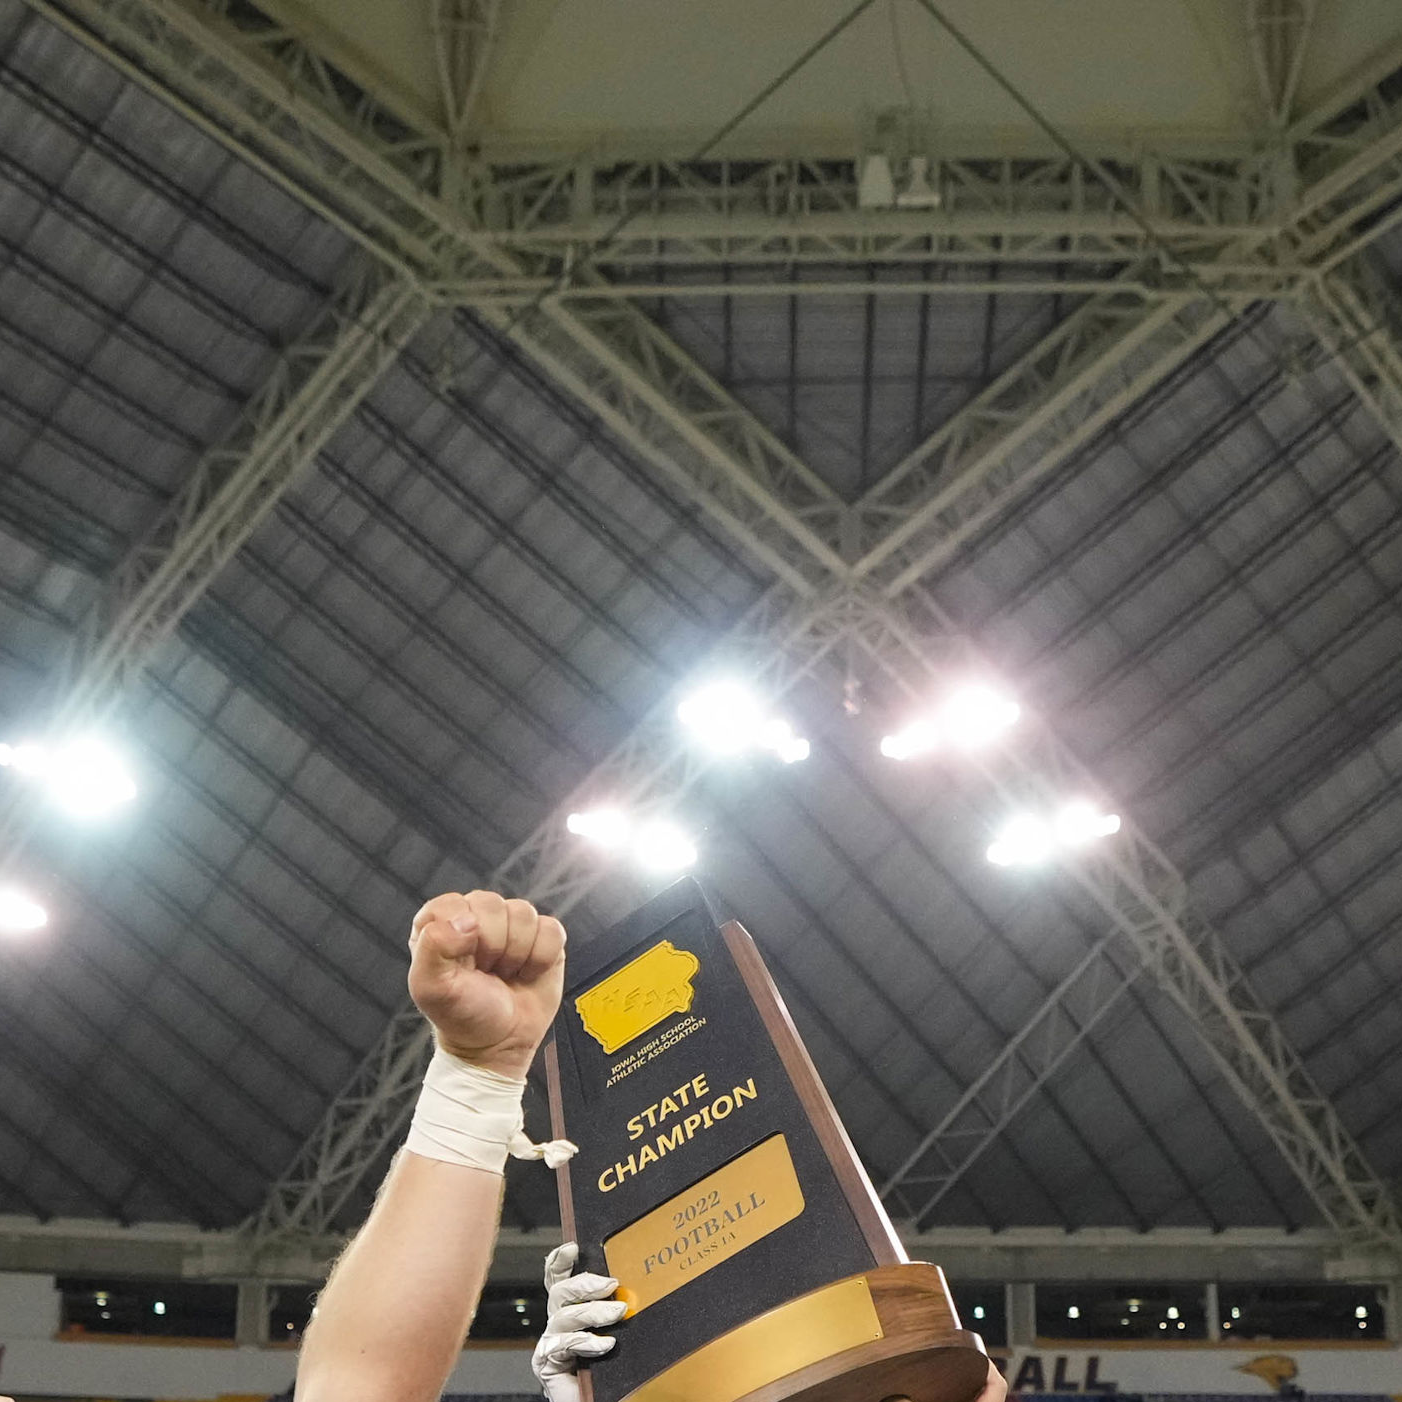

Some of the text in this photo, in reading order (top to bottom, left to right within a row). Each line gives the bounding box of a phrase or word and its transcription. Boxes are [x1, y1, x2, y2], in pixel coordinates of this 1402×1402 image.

[606, 1017, 707, 1088] ATHLETIC ASSOCIATION
[611, 1015, 697, 1075] IOWA HIGH SCHOOL
[597, 1078, 759, 1194] CHAMPION
[626, 1073, 711, 1141] STATE
[643, 1191, 766, 1276] FOOTBALL
[672, 1190, 721, 1231] 2022
[679, 1242, 719, 1271] CLASS
[995, 1356, 1118, 1392] ALL
